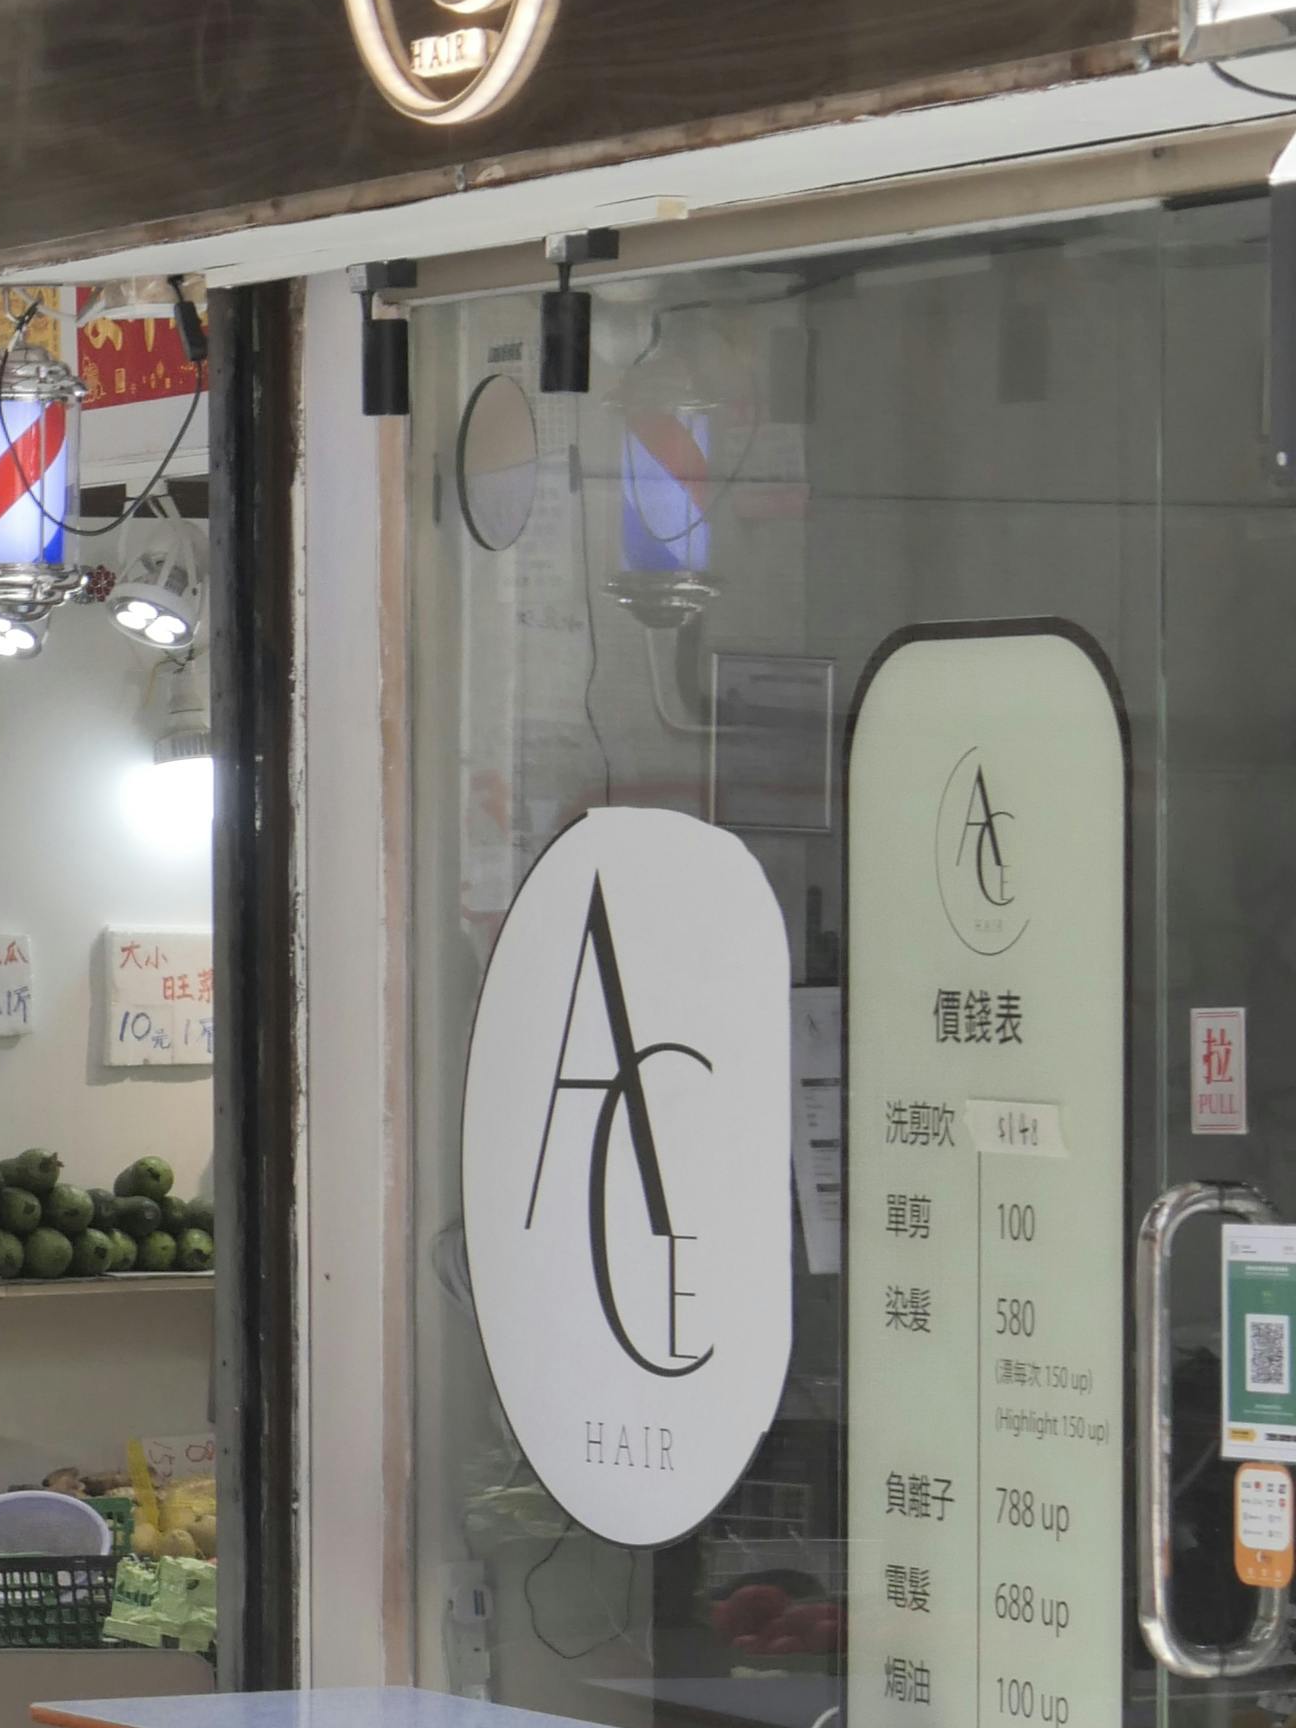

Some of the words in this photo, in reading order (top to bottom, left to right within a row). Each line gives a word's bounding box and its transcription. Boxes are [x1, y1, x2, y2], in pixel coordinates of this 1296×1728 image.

[119, 941, 168, 971] 大小
[933, 988, 1023, 1045] 價錢表
[1202, 1027, 1233, 1085] 拉
[885, 1100, 956, 1148] 洗剪吹
[1198, 1093, 1237, 1115] PULL
[885, 1192, 932, 1240] 單剪
[996, 1203, 1036, 1243] 100
[885, 1285, 932, 1334] 染髮
[995, 1297, 1036, 1338] 580
[585, 1420, 676, 1472] HAIR
[885, 1470, 956, 1522] 負離子
[995, 1486, 1035, 1529] 788
[1040, 1502, 1070, 1542] up
[994, 1581, 1035, 1624] 688
[1040, 1596, 1070, 1638] up
[884, 1655, 932, 1707] 焗油
[996, 1676, 1035, 1719] 100
